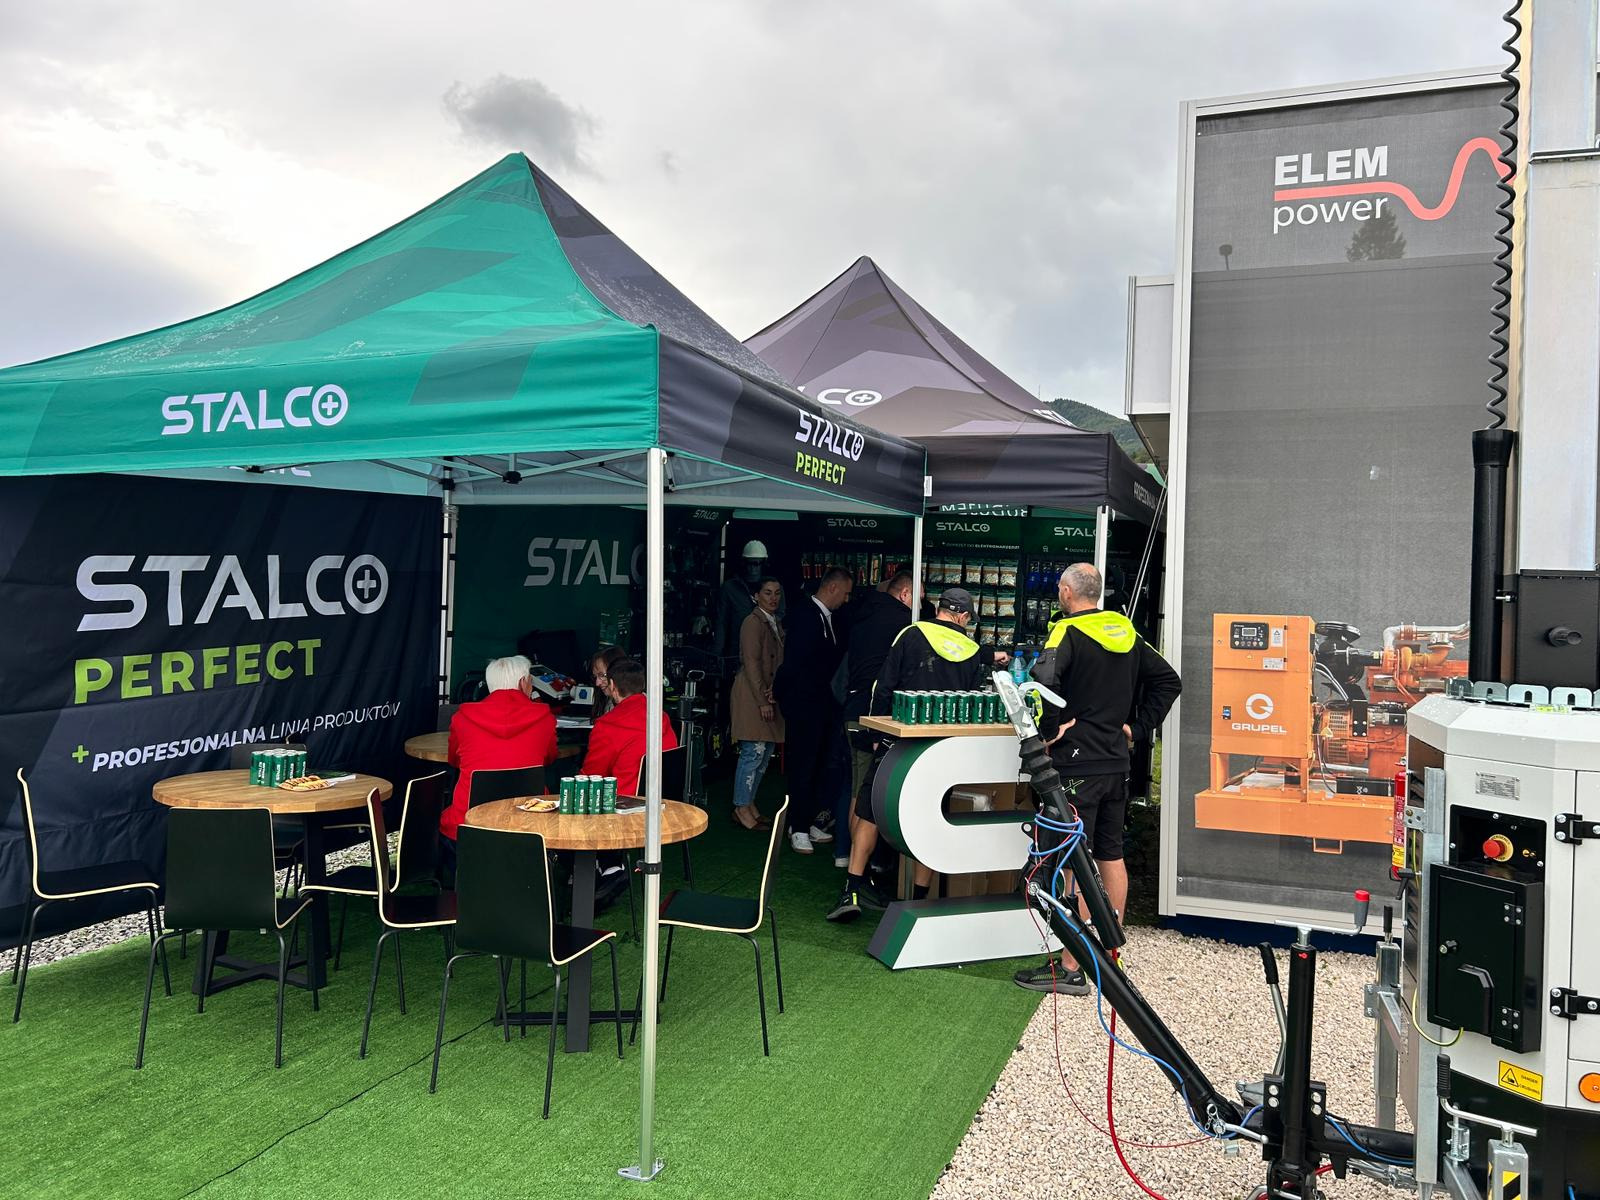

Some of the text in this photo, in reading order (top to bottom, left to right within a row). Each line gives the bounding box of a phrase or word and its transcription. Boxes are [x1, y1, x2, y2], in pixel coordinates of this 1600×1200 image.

[1274, 145, 1388, 186] ELEM
[1273, 197, 1388, 234] power
[161, 383, 349, 435] STALCO
[795, 409, 865, 461] STALCO
[795, 451, 846, 485] PERFECT
[827, 518, 878, 528] STALCO
[936, 521, 990, 533] STALCO
[75, 554, 389, 632] STALCO
[74, 638, 321, 704] PERFECT
[92, 701, 401, 772] PROFESJONALNA LINIA PRODUKTÓW
[1231, 722, 1288, 733] GRUPEL
